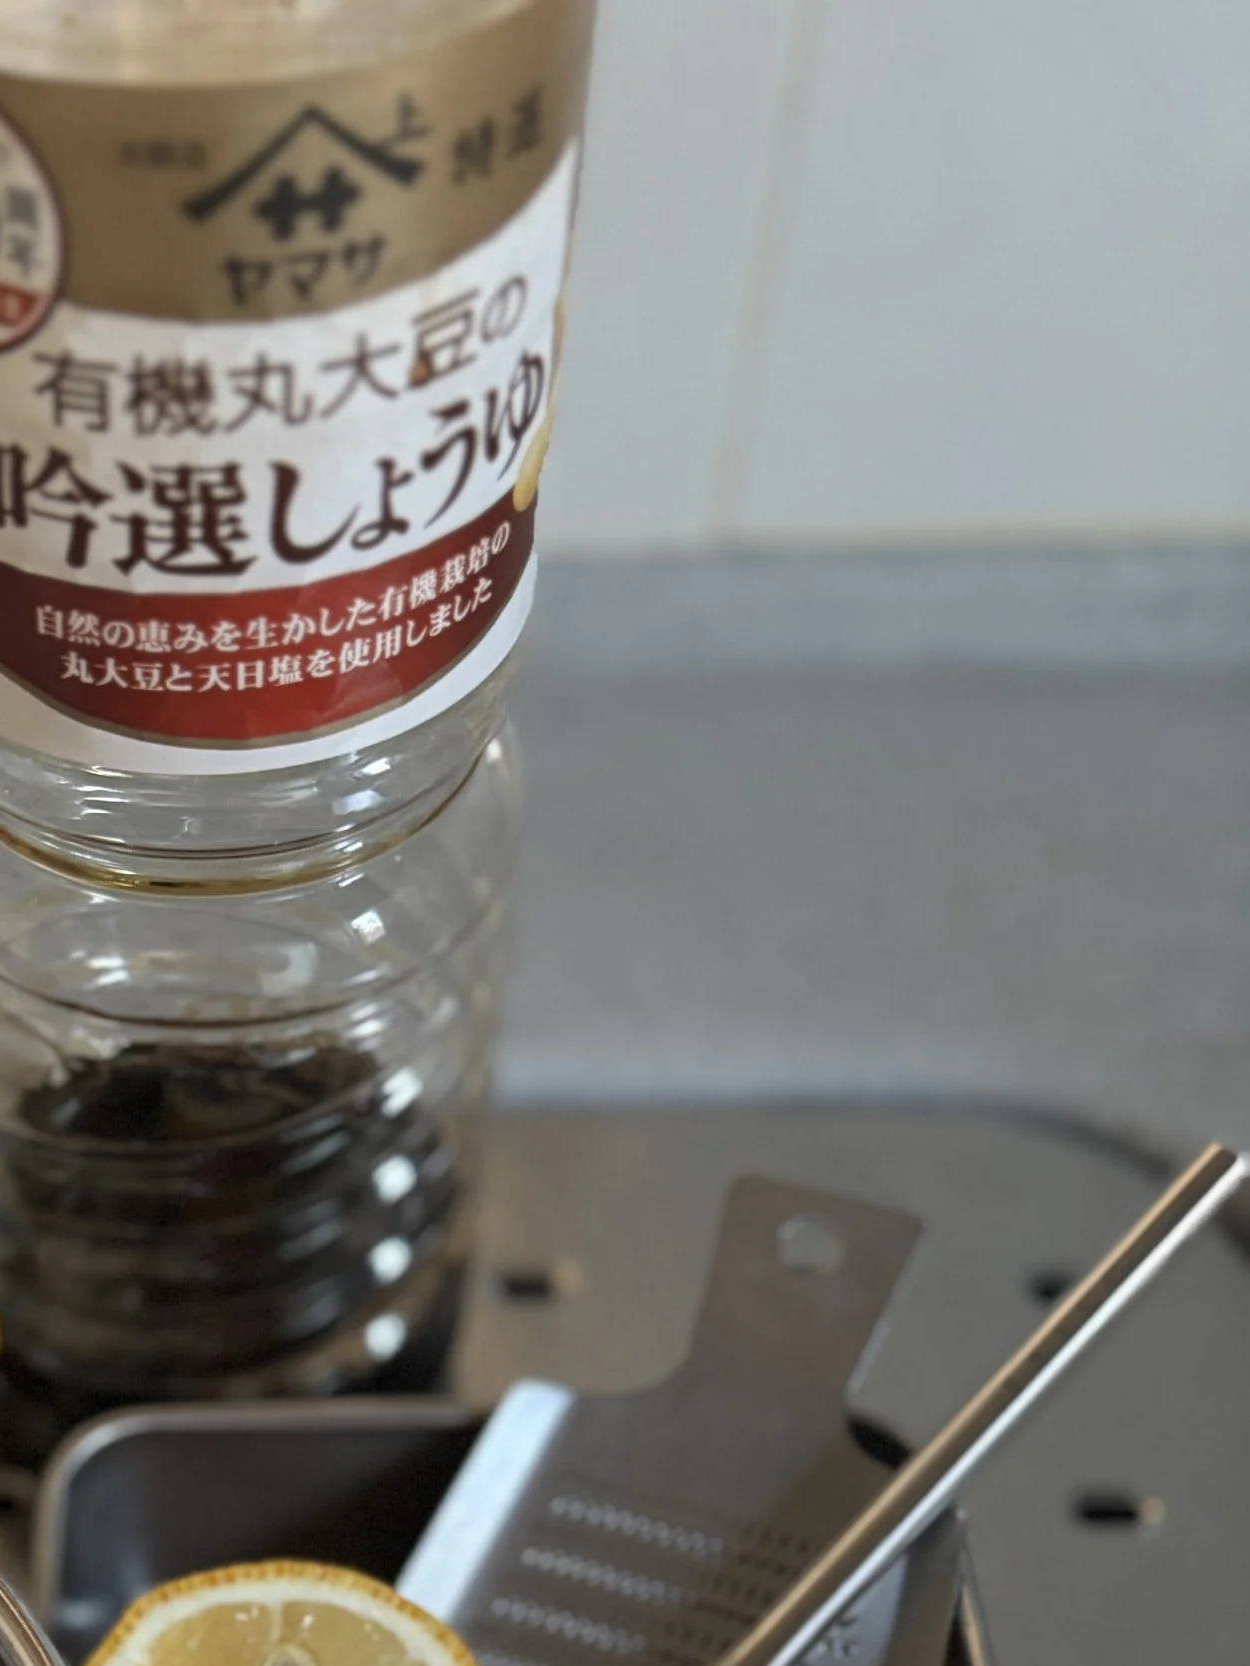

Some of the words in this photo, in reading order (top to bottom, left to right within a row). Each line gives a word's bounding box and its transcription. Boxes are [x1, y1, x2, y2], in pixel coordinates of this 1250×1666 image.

[224, 232, 385, 305] ヤマサ
[33, 273, 529, 439] 有機丸大豆の
[36, 520, 511, 654] 自然の恵みを生かした有機栽培の
[61, 577, 493, 692] 丸大豆と天日塩を使用しました
